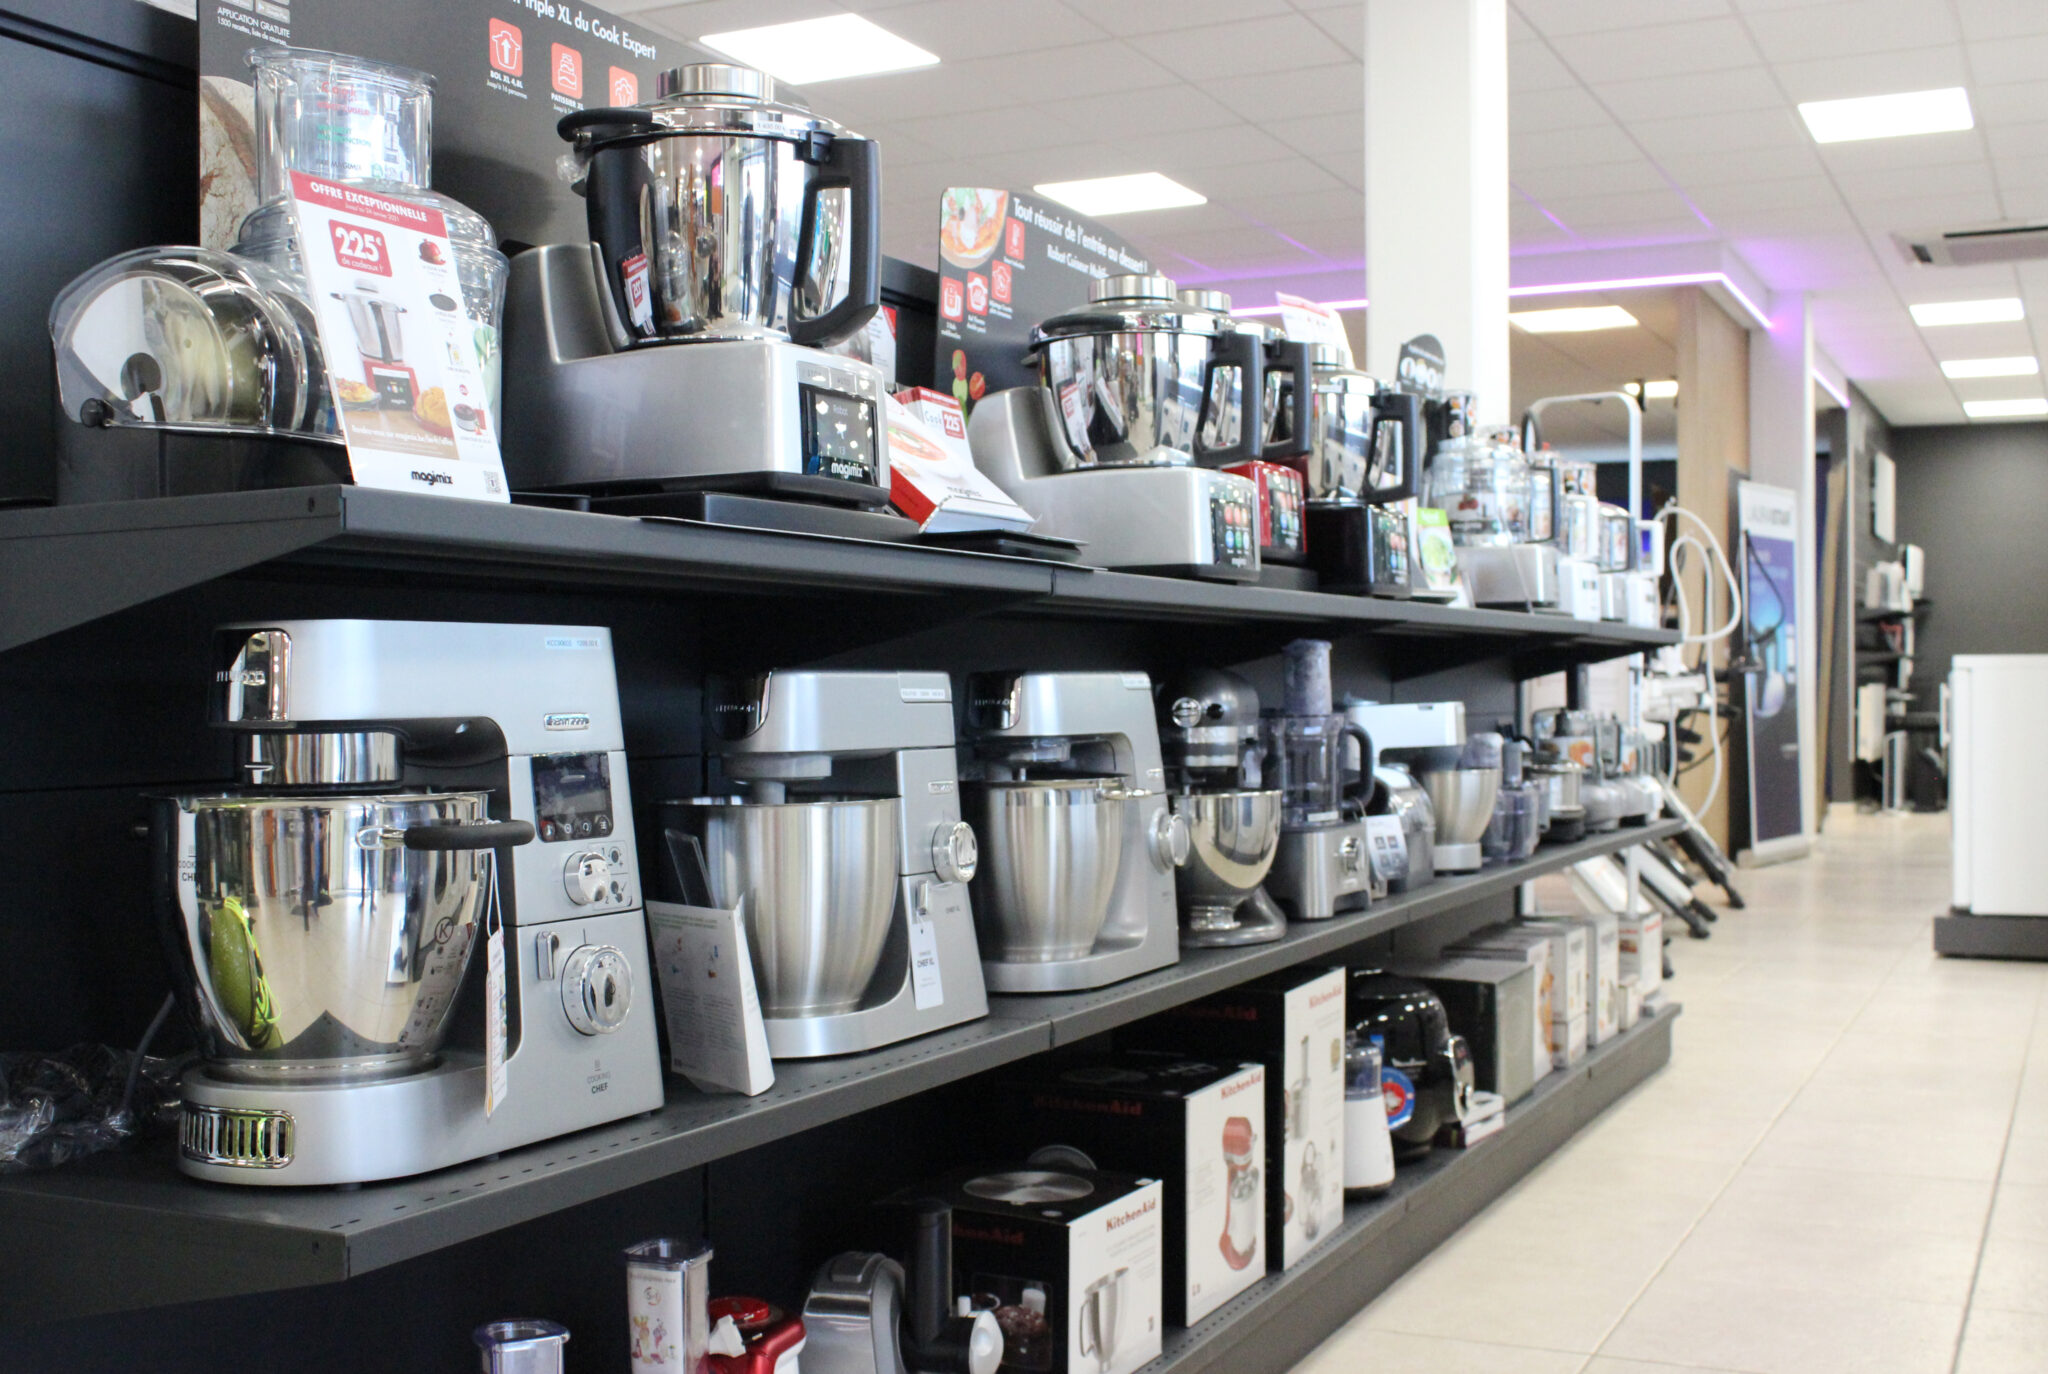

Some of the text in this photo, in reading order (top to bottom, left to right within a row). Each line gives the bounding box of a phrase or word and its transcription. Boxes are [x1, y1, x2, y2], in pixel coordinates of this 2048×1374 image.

[217, 6, 259, 27] APPLICATION
[260, 20, 290, 38] GRATUITE
[557, 4, 572, 26] XL
[574, 11, 589, 32] du
[591, 19, 620, 45] Cook
[622, 31, 656, 60] Expert
[310, 181, 427, 223] OFFRE EXCEPTIONNELLE
[1014, 197, 1033, 223] Tout
[1064, 220, 1076, 243] de
[411, 471, 453, 486] magimix
[831, 462, 862, 479] magimix
[591, 1082, 608, 1094] CHEF
[1106, 1198, 1156, 1232] KitchenAid
